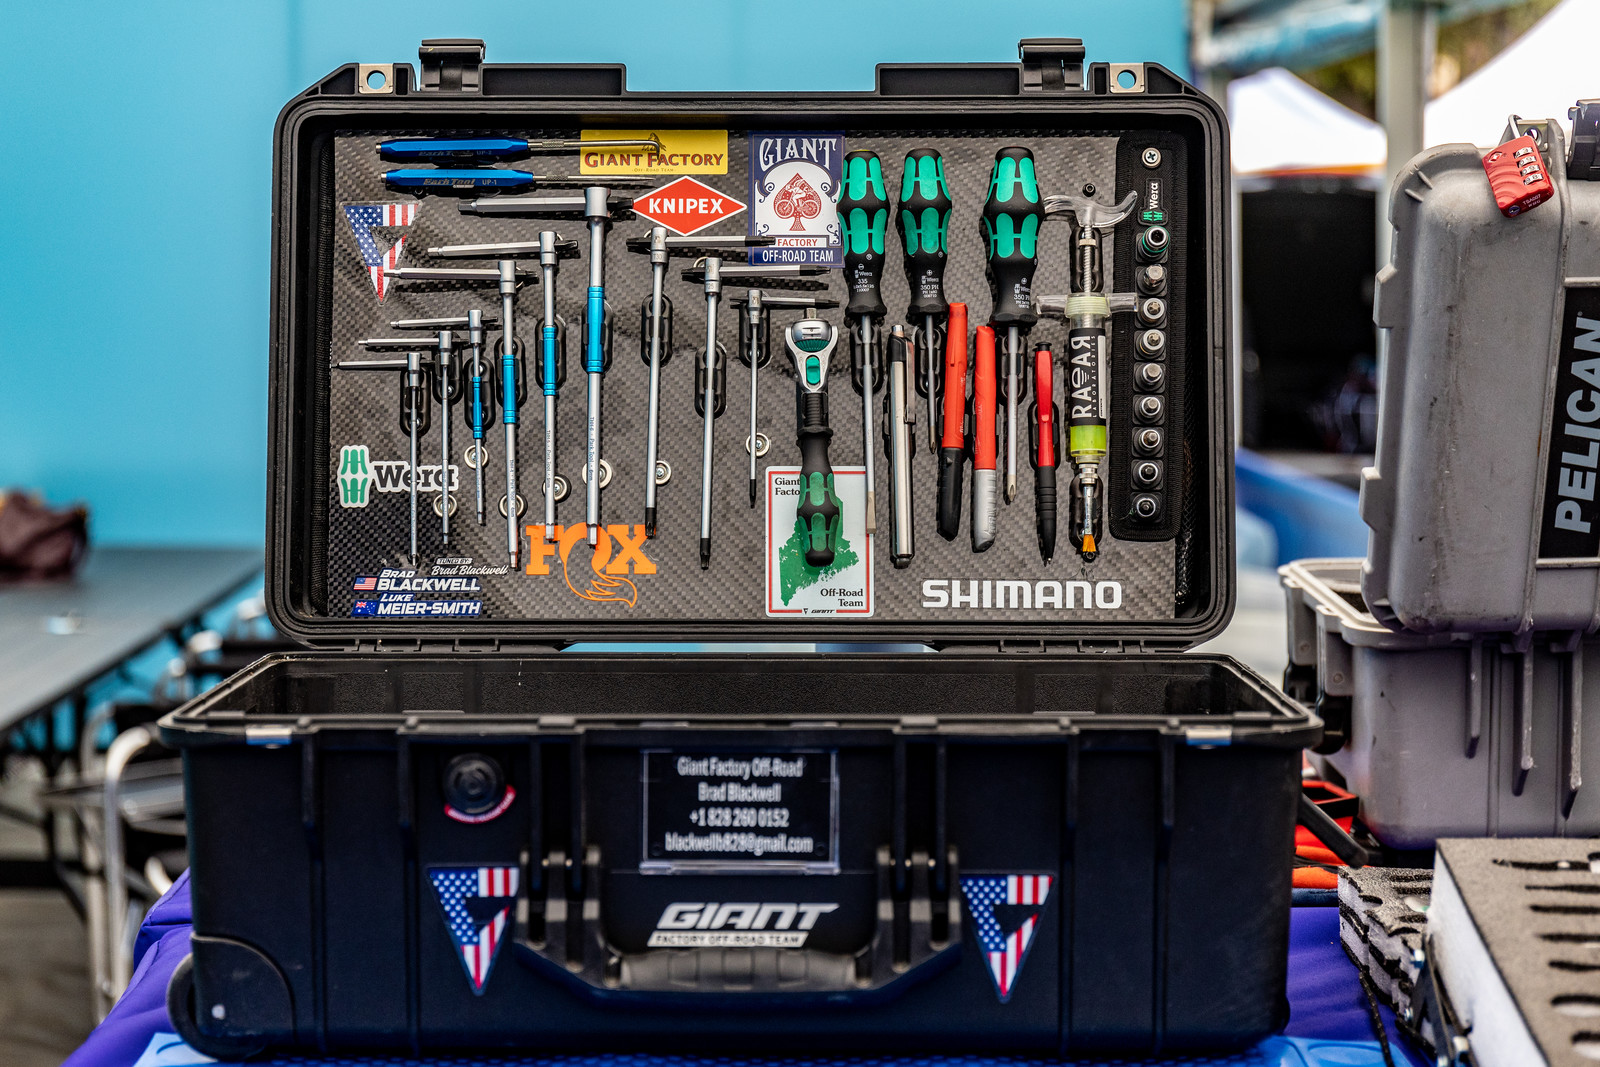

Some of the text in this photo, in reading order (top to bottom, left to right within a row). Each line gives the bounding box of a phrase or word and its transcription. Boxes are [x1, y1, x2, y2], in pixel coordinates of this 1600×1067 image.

[584, 152, 724, 168] GIANT FACTORY
[760, 138, 837, 172] GIANT
[1150, 182, 1158, 210] Wera
[650, 198, 724, 214] KNIPEX
[777, 238, 818, 247] FACTORY
[762, 250, 834, 262] OFF-ROAD TEAM
[1555, 316, 1600, 533] PELICAN
[374, 465, 454, 488] Wera
[774, 477, 800, 486] Giant
[774, 488, 800, 496] Facto
[526, 522, 656, 577] FOX
[380, 570, 416, 578] BRAD
[431, 564, 509, 576] Brad Blackwell
[377, 578, 481, 590] BLACKWELL
[380, 594, 414, 602] LUKE
[820, 588, 863, 596] Off-Road
[922, 580, 1122, 609] SHIMANO
[377, 602, 481, 614] MEIER-SMITH
[838, 598, 863, 606] Team
[677, 756, 803, 780] Giant Factory Off-Road
[698, 782, 782, 802] Brad Blackwell
[690, 807, 706, 827] +1
[656, 902, 840, 930] GIANT
[656, 935, 800, 944] FACTORY OFF-ROAD TEAM
